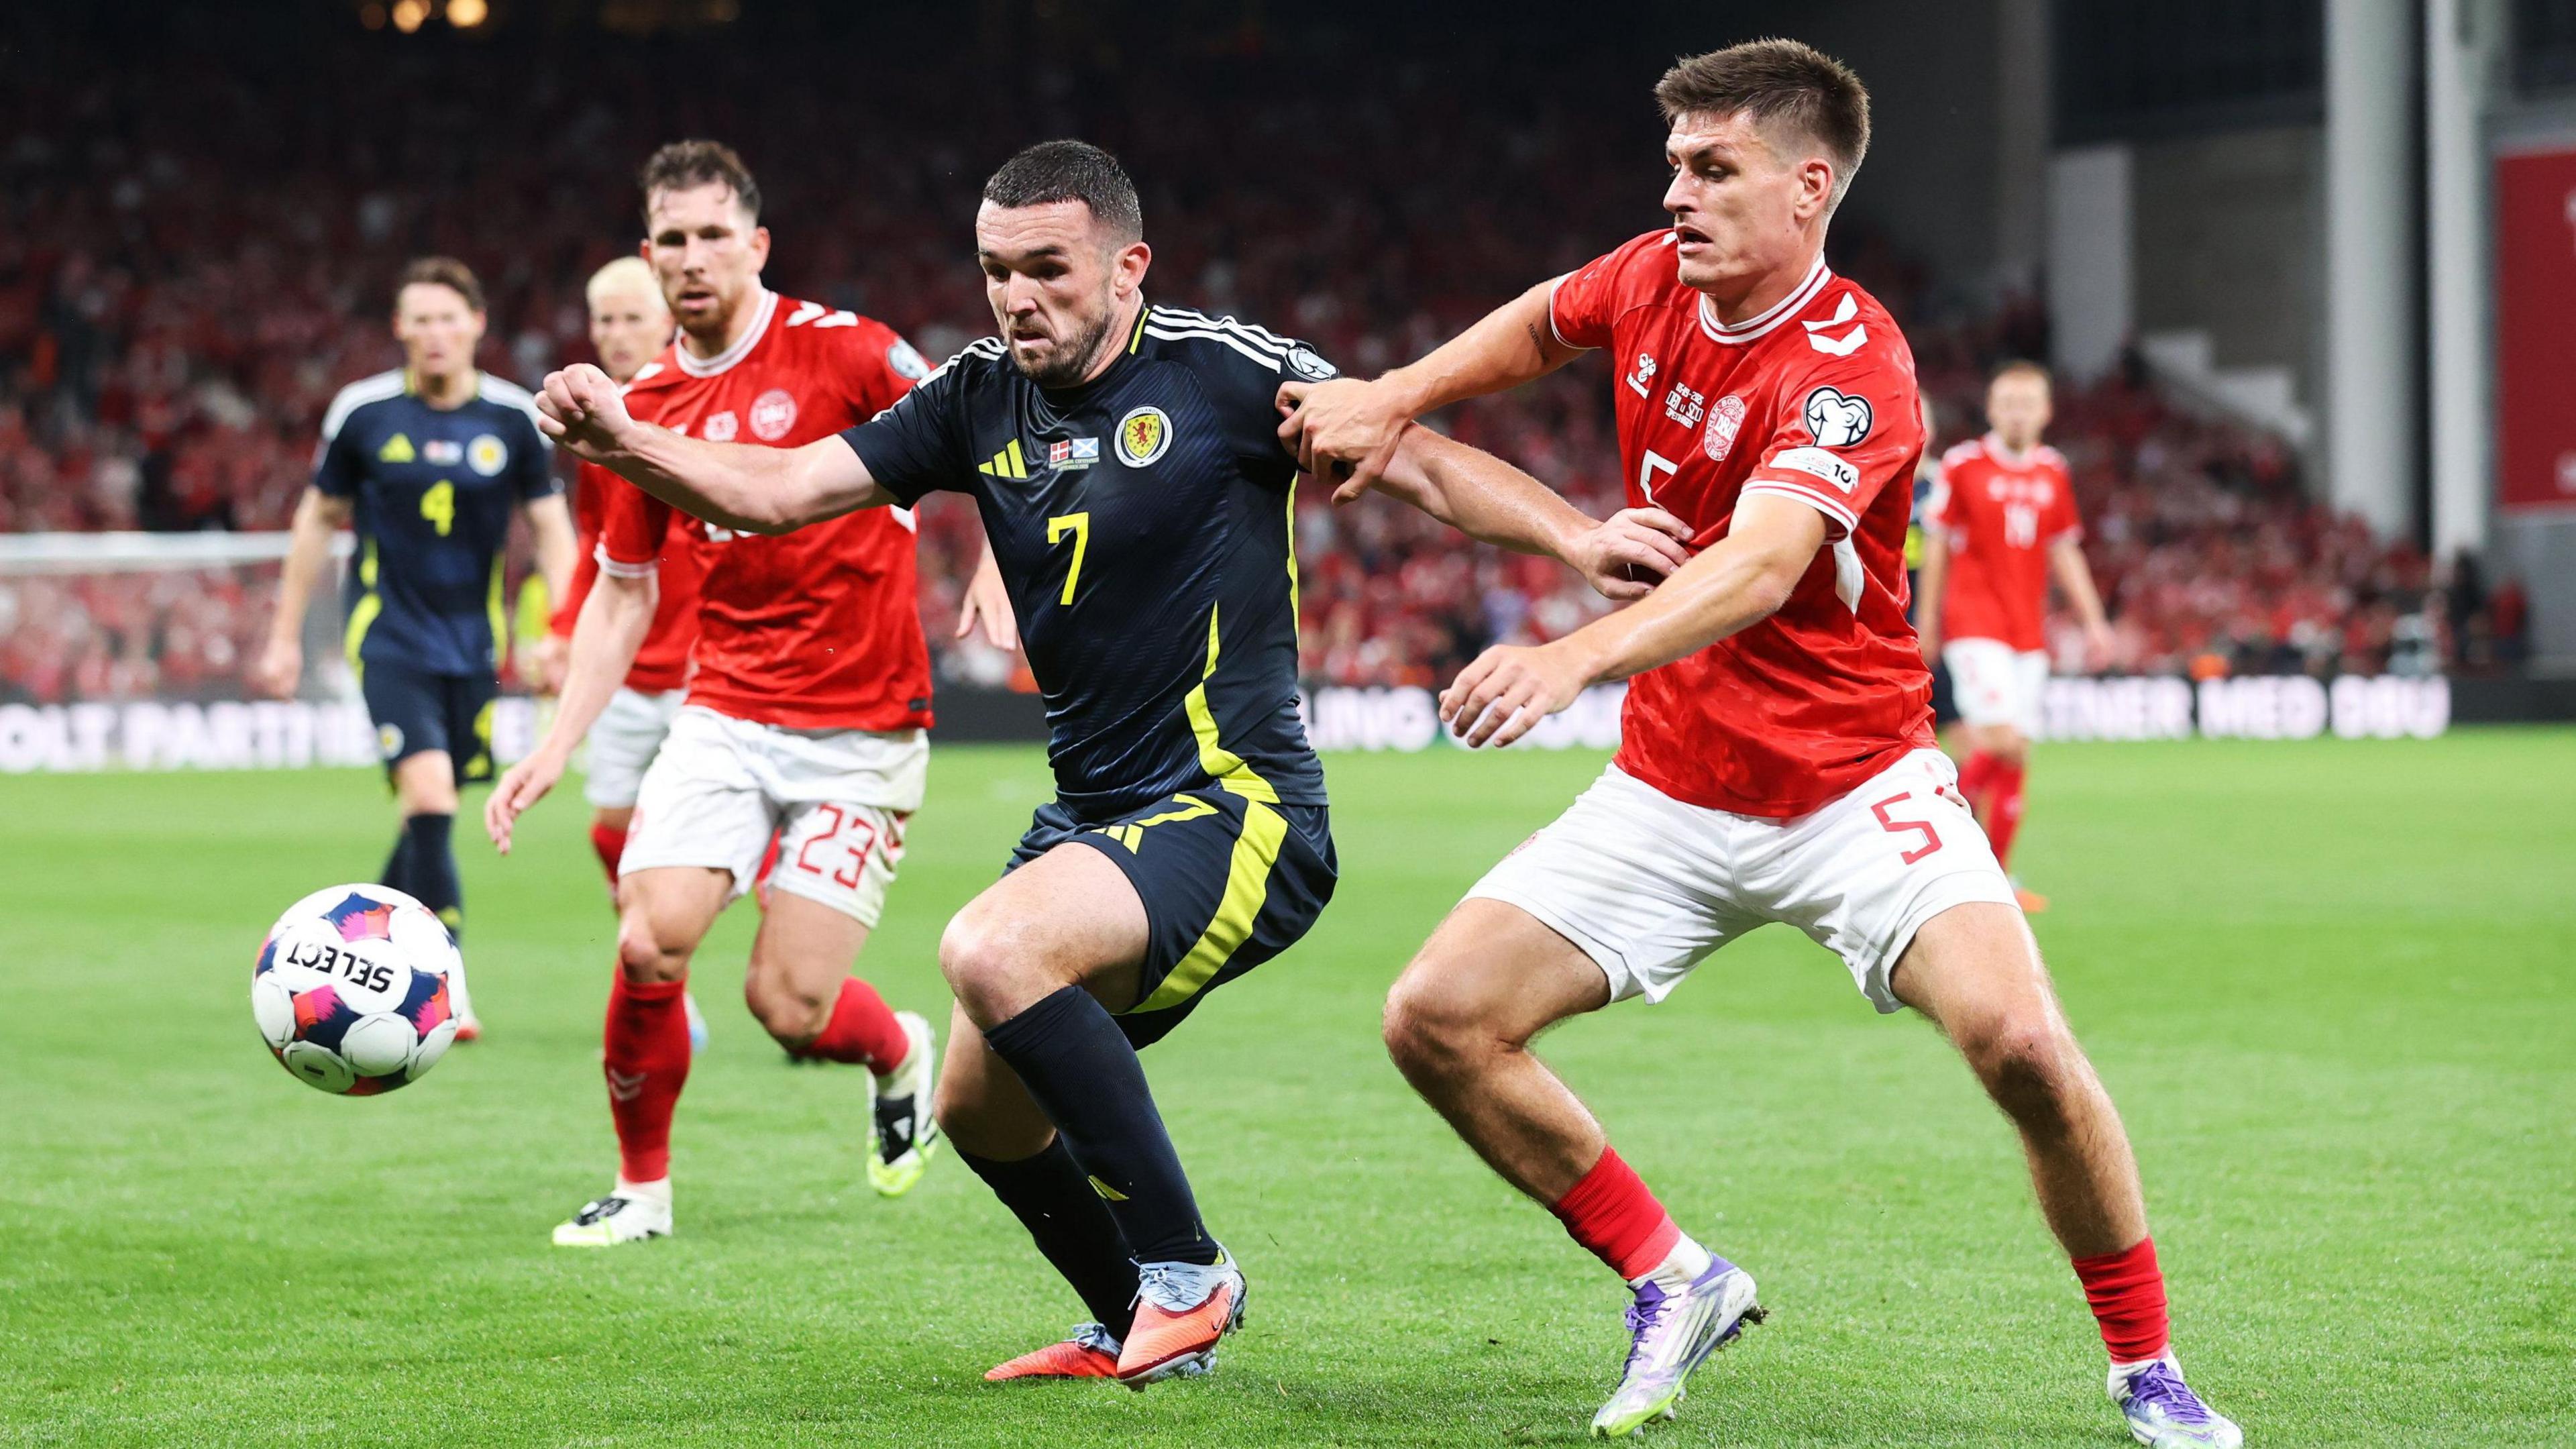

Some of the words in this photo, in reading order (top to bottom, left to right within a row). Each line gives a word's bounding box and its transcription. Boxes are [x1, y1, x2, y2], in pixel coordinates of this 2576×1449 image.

[1685, 402, 1704, 422] SCO
[420, 478, 455, 537] 4
[1046, 512, 1089, 606] 7
[123, 698, 388, 771] PARTNE
[2041, 675, 2194, 742] TNER
[2196, 675, 2328, 739] MED
[1134, 793, 1220, 827] 7
[1870, 791, 1943, 865] 5
[797, 802, 876, 890] 23
[286, 941, 394, 994] SELECT
